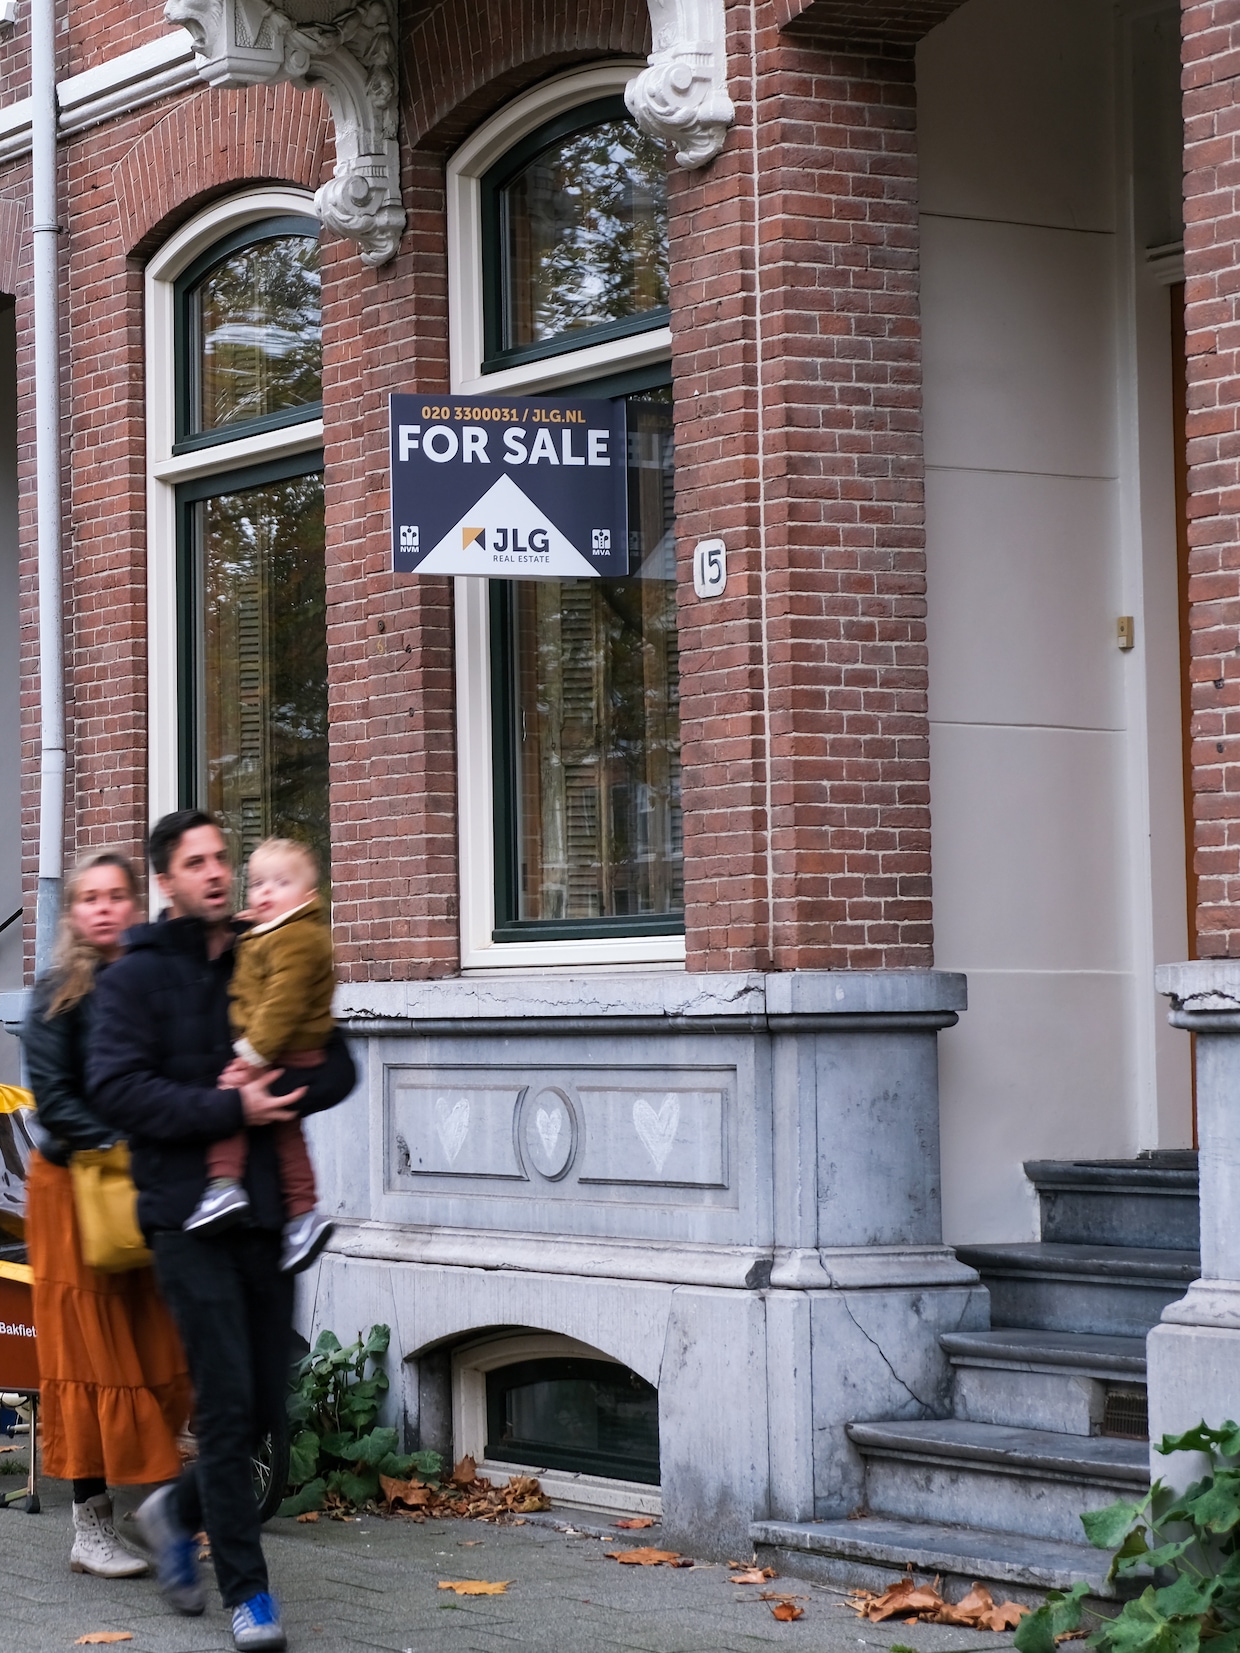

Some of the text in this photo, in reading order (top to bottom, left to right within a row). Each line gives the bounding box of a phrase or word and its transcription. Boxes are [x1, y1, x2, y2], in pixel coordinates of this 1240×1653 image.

[421, 406, 586, 423] 020 3300031 / JLG.NL
[399, 425, 610, 466] FOR SALE
[493, 528, 550, 553] JLG
[493, 554, 550, 564] REAL ESTATE
[700, 549, 722, 585] 15
